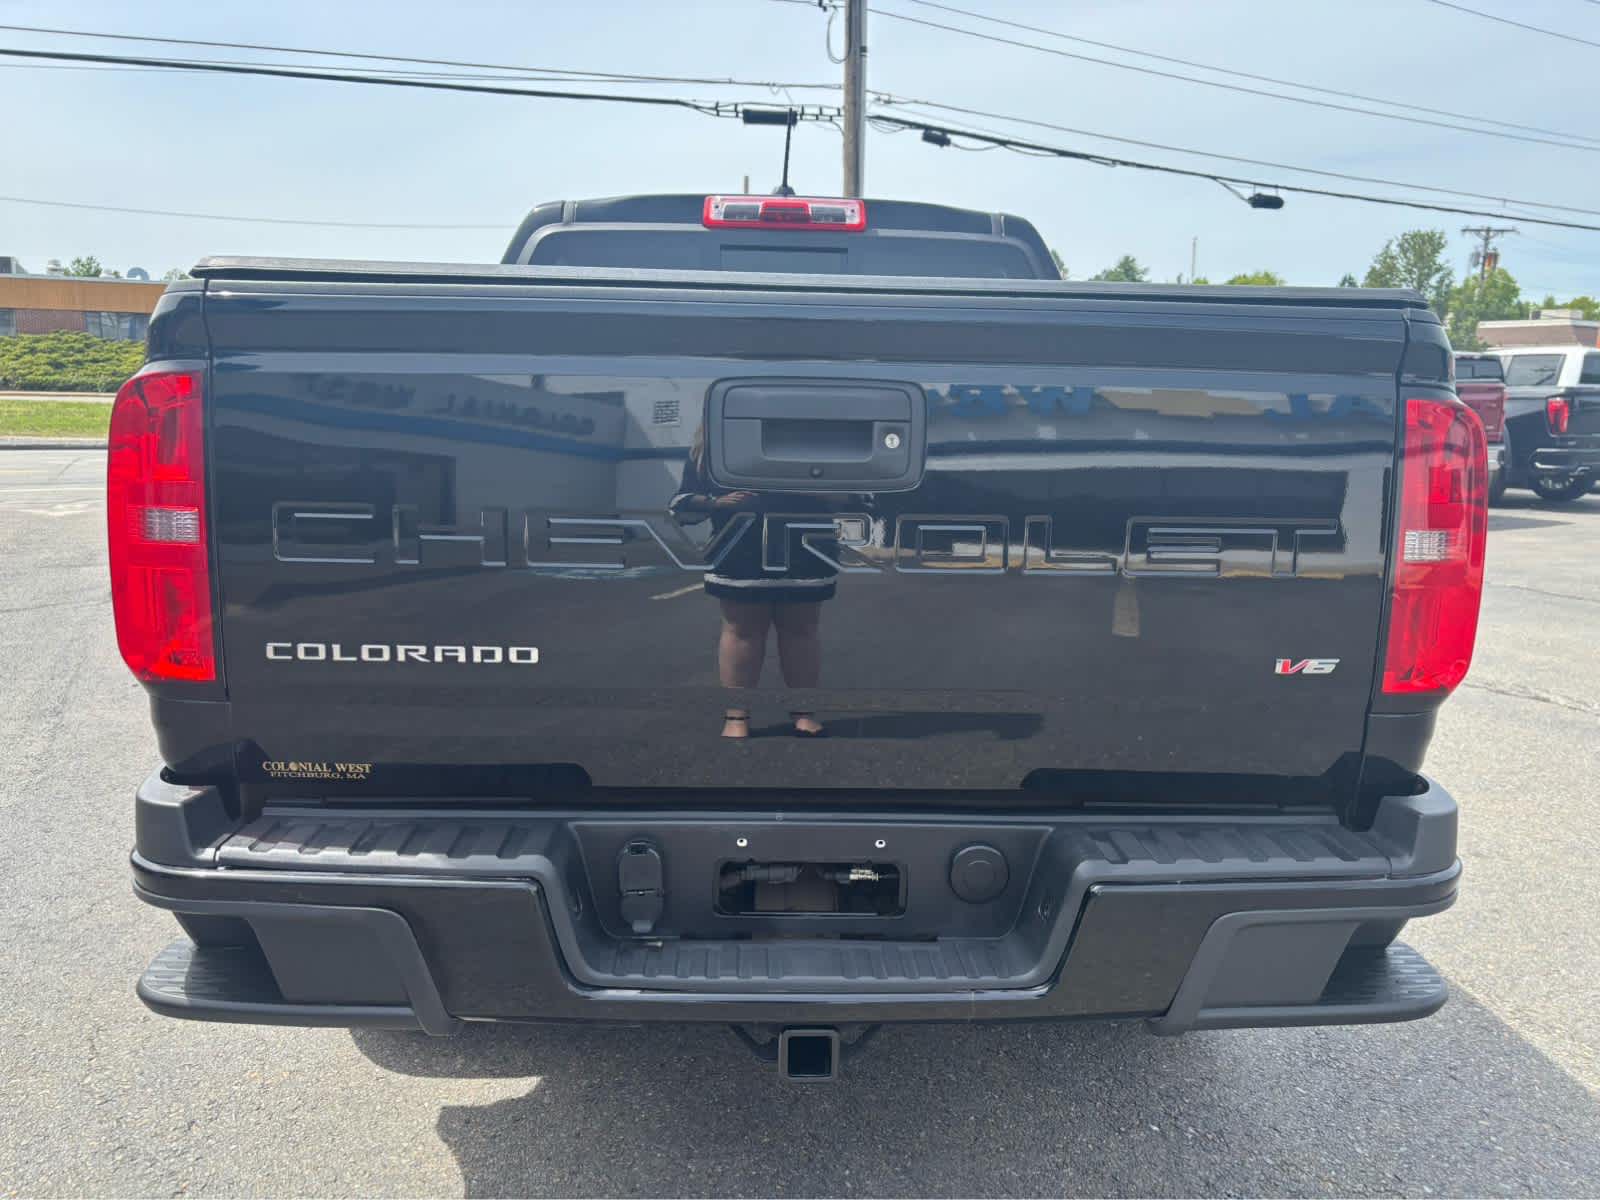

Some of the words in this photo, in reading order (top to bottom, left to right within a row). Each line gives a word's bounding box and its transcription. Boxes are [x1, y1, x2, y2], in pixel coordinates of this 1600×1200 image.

[272, 502, 1340, 578] CHEVROLET
[265, 642, 539, 664] COLORADO
[1274, 658, 1340, 674] V6
[335, 763, 372, 773] WEST
